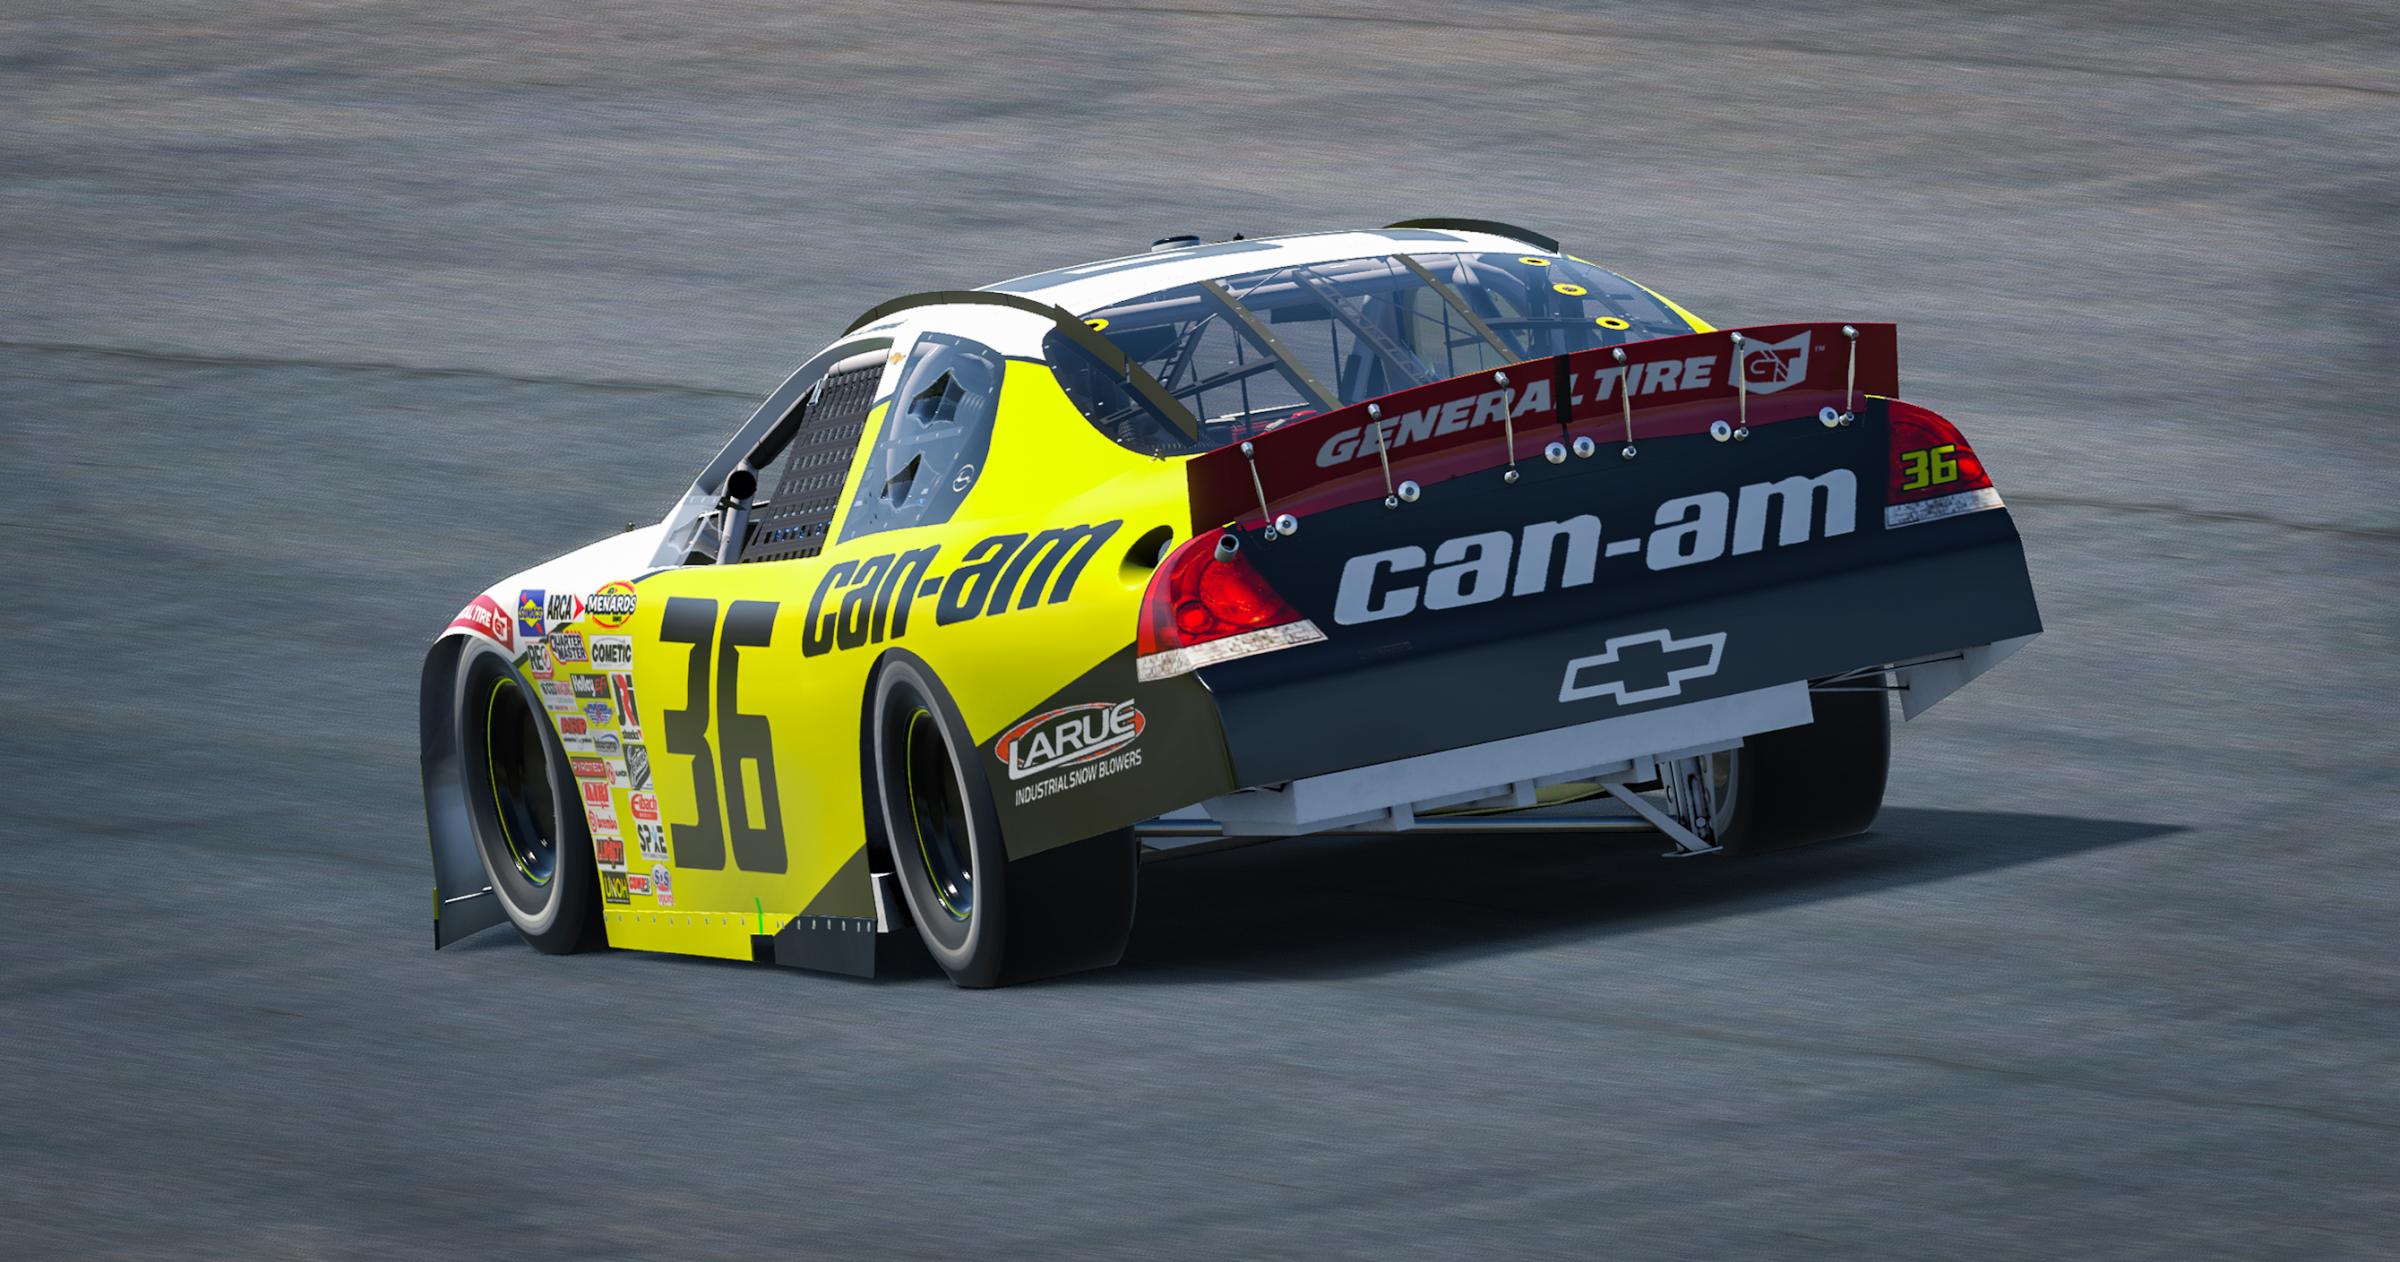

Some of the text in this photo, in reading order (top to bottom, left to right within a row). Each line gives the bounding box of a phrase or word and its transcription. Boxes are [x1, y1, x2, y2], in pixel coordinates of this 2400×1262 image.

[1594, 356, 1717, 402] TIRE
[1902, 444, 1958, 492] 36
[1333, 468, 1858, 626] can-am
[802, 519, 1124, 659] can-am
[472, 605, 492, 628] TIRE
[546, 594, 572, 620] ARCA
[586, 593, 637, 615] MENARDS
[550, 634, 582, 649] QUARTER
[558, 646, 587, 660] MASTER
[592, 643, 632, 663] COMETIC
[571, 674, 596, 697] Holley
[659, 596, 789, 875] 36
[1009, 698, 1137, 781] LARUE
[1015, 748, 1143, 807] INDUSTRIAL SNOW BLOWERS
[604, 875, 629, 898] UNOH
